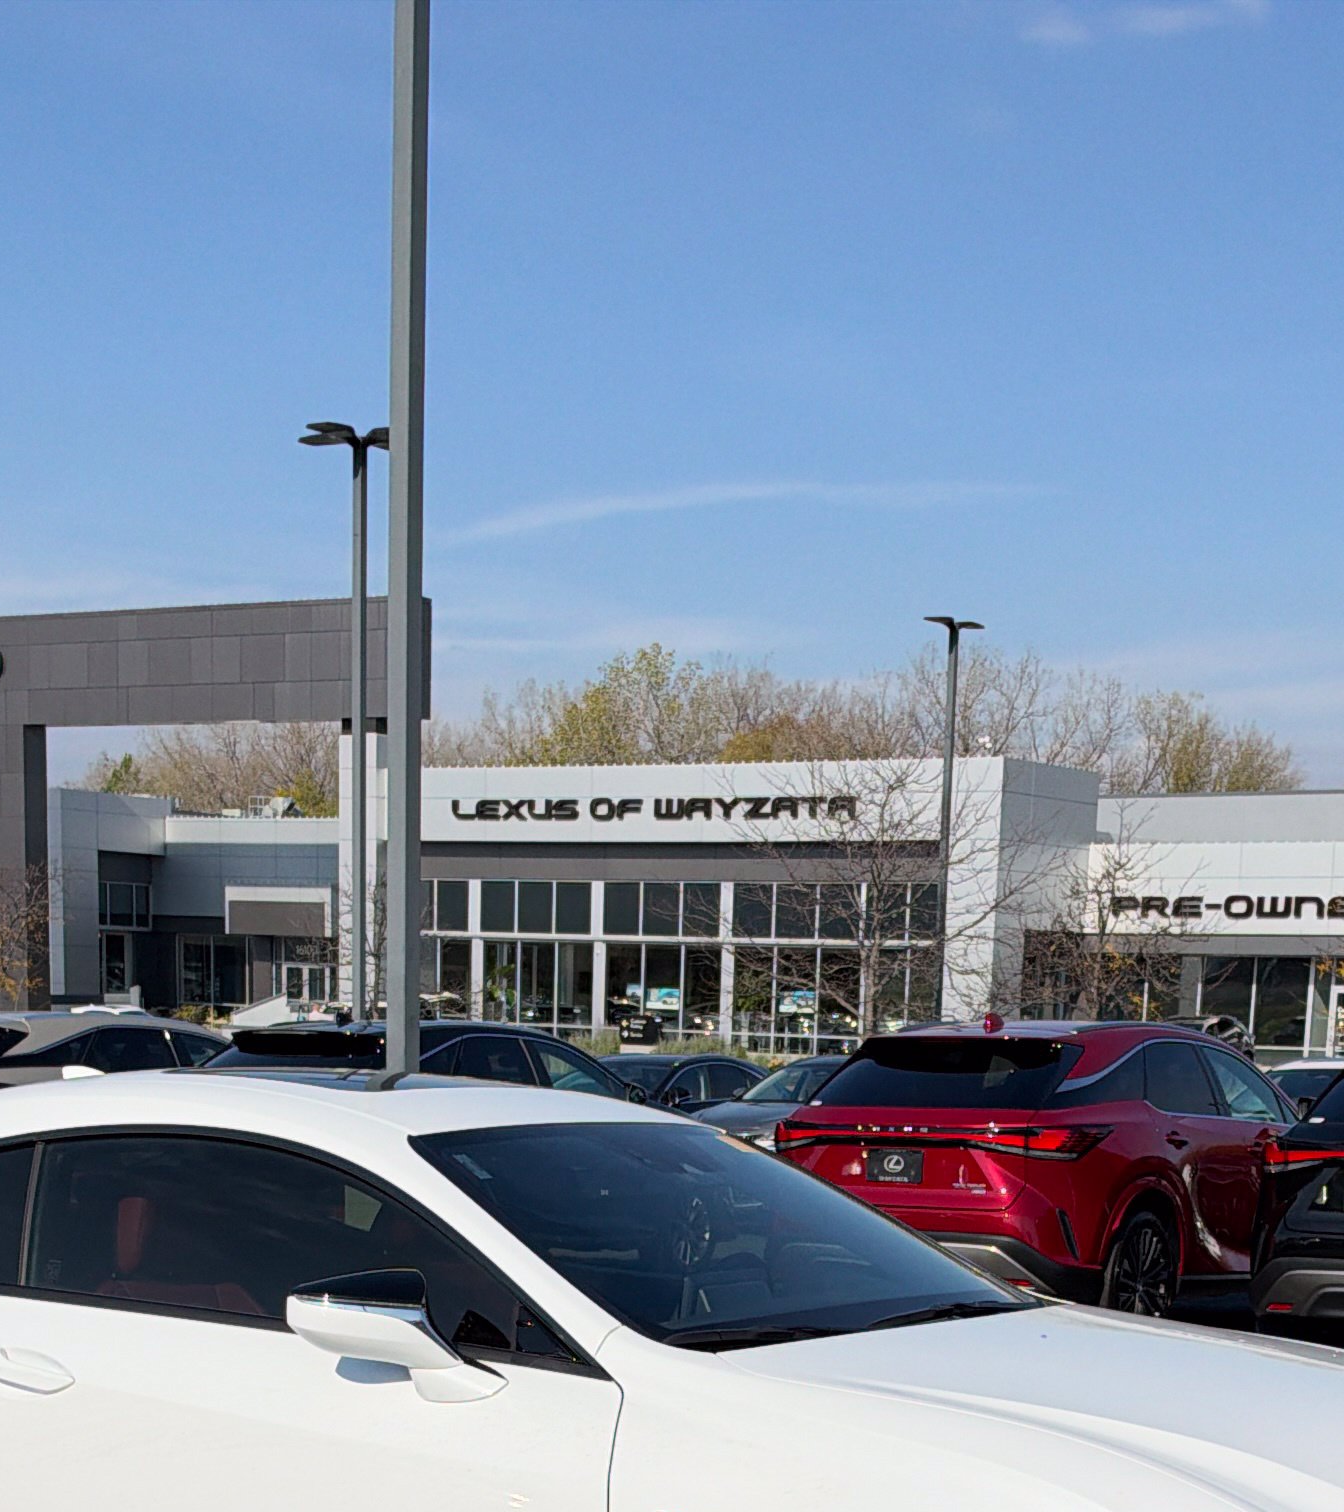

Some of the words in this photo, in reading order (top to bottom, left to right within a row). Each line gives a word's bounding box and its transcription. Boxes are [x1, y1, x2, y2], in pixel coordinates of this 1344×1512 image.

[451, 799, 580, 821] LEXUS
[589, 797, 644, 822] OF
[653, 797, 857, 820] WAYZATA
